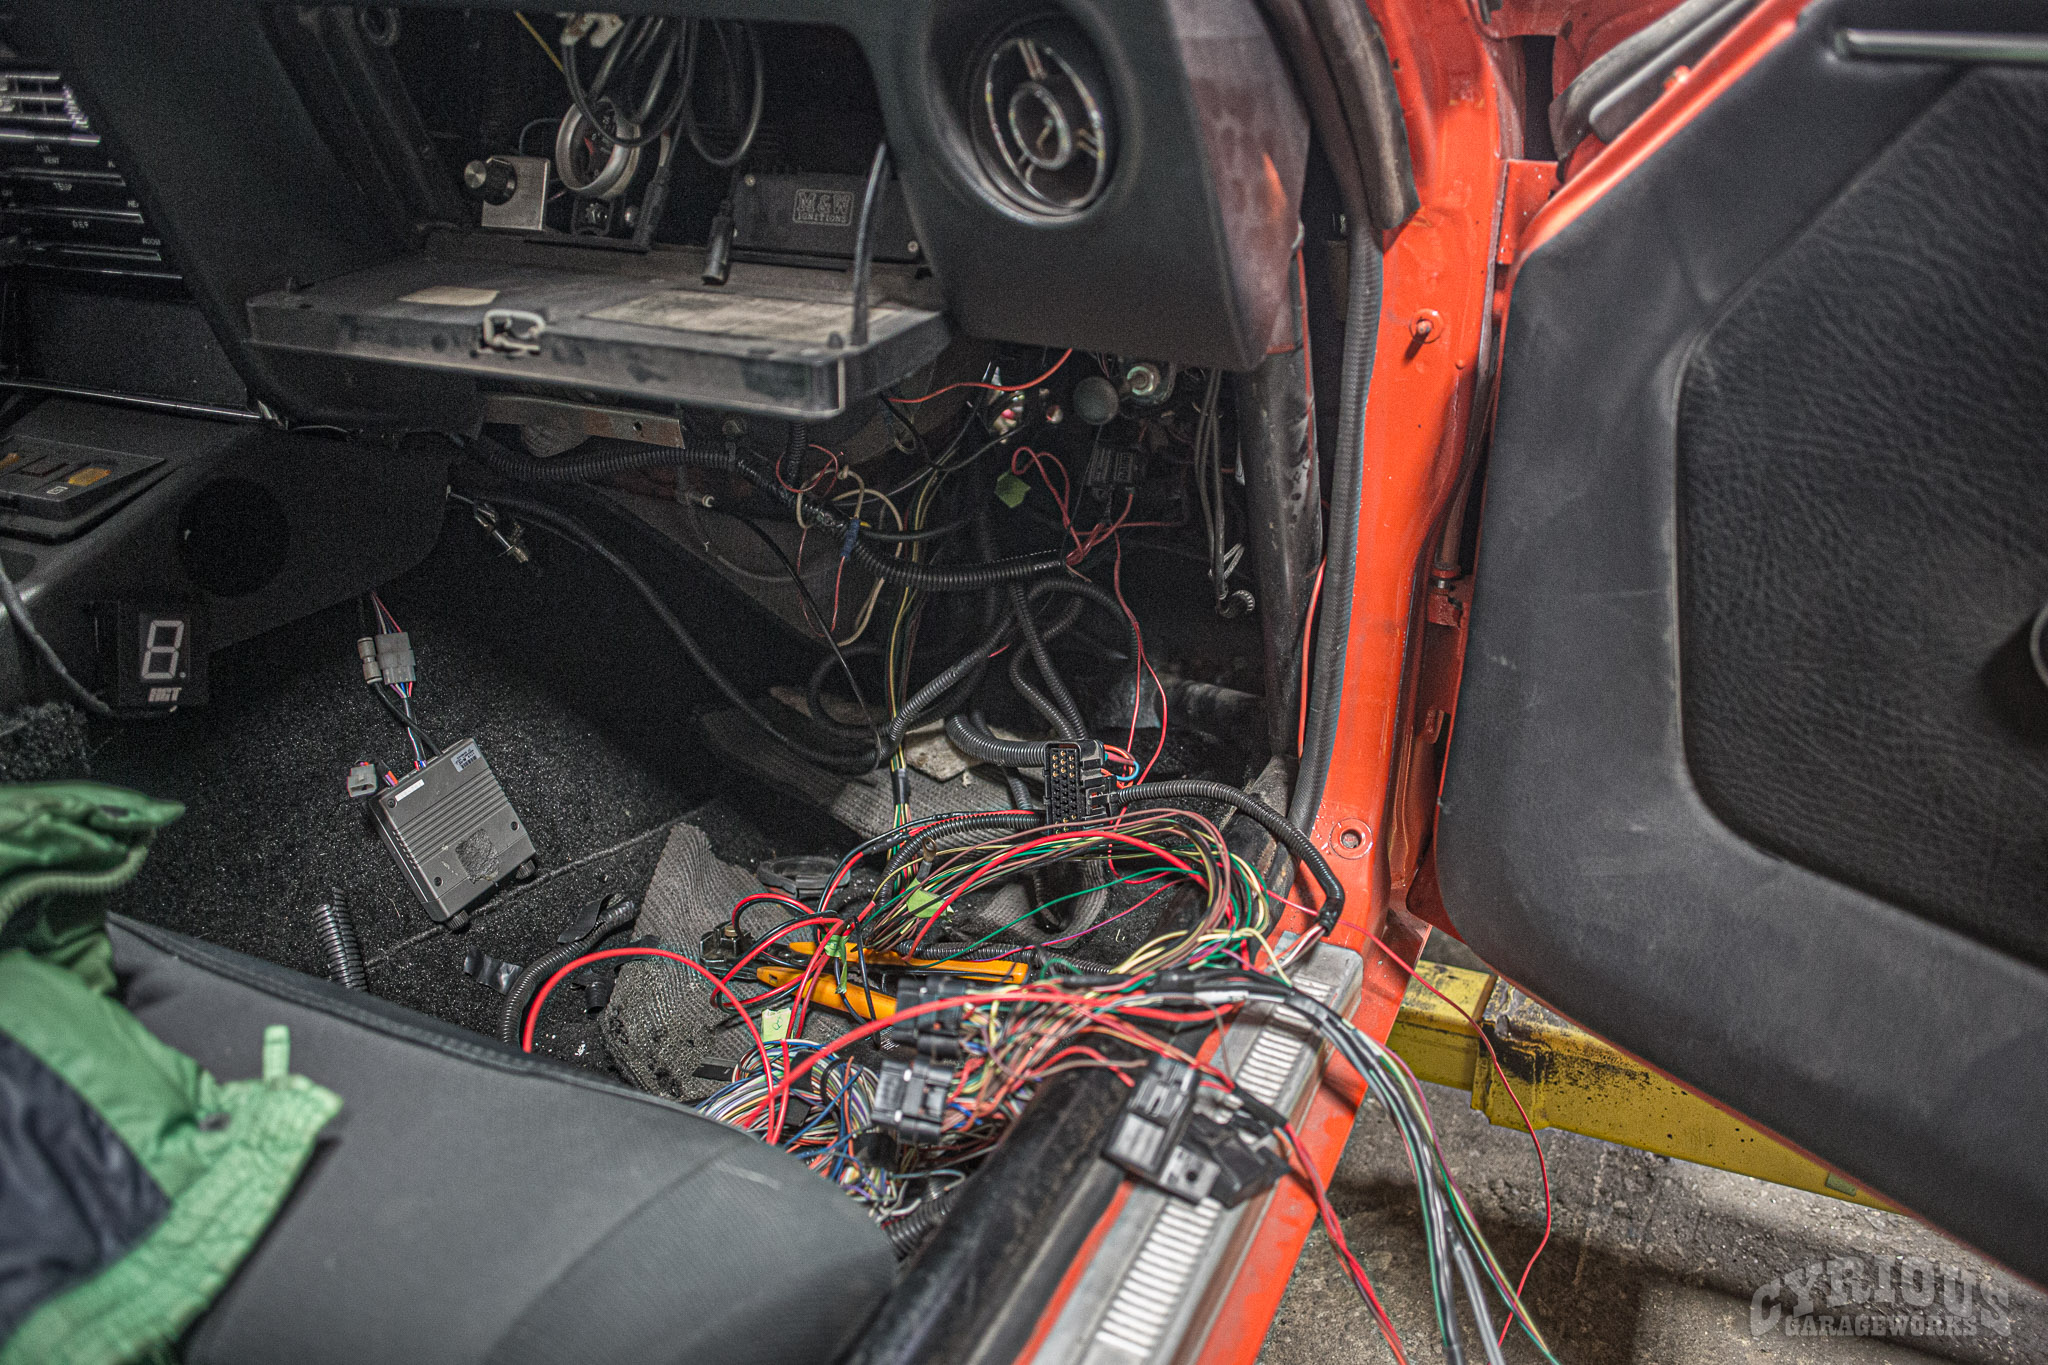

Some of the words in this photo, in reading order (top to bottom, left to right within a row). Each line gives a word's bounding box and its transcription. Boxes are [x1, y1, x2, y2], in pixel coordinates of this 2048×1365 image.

[43, 156, 60, 165] VENT
[53, 182, 73, 192] TEMP
[797, 211, 847, 223] IGNITIONS
[72, 220, 89, 229] DEF
[142, 237, 162, 246] ROOM
